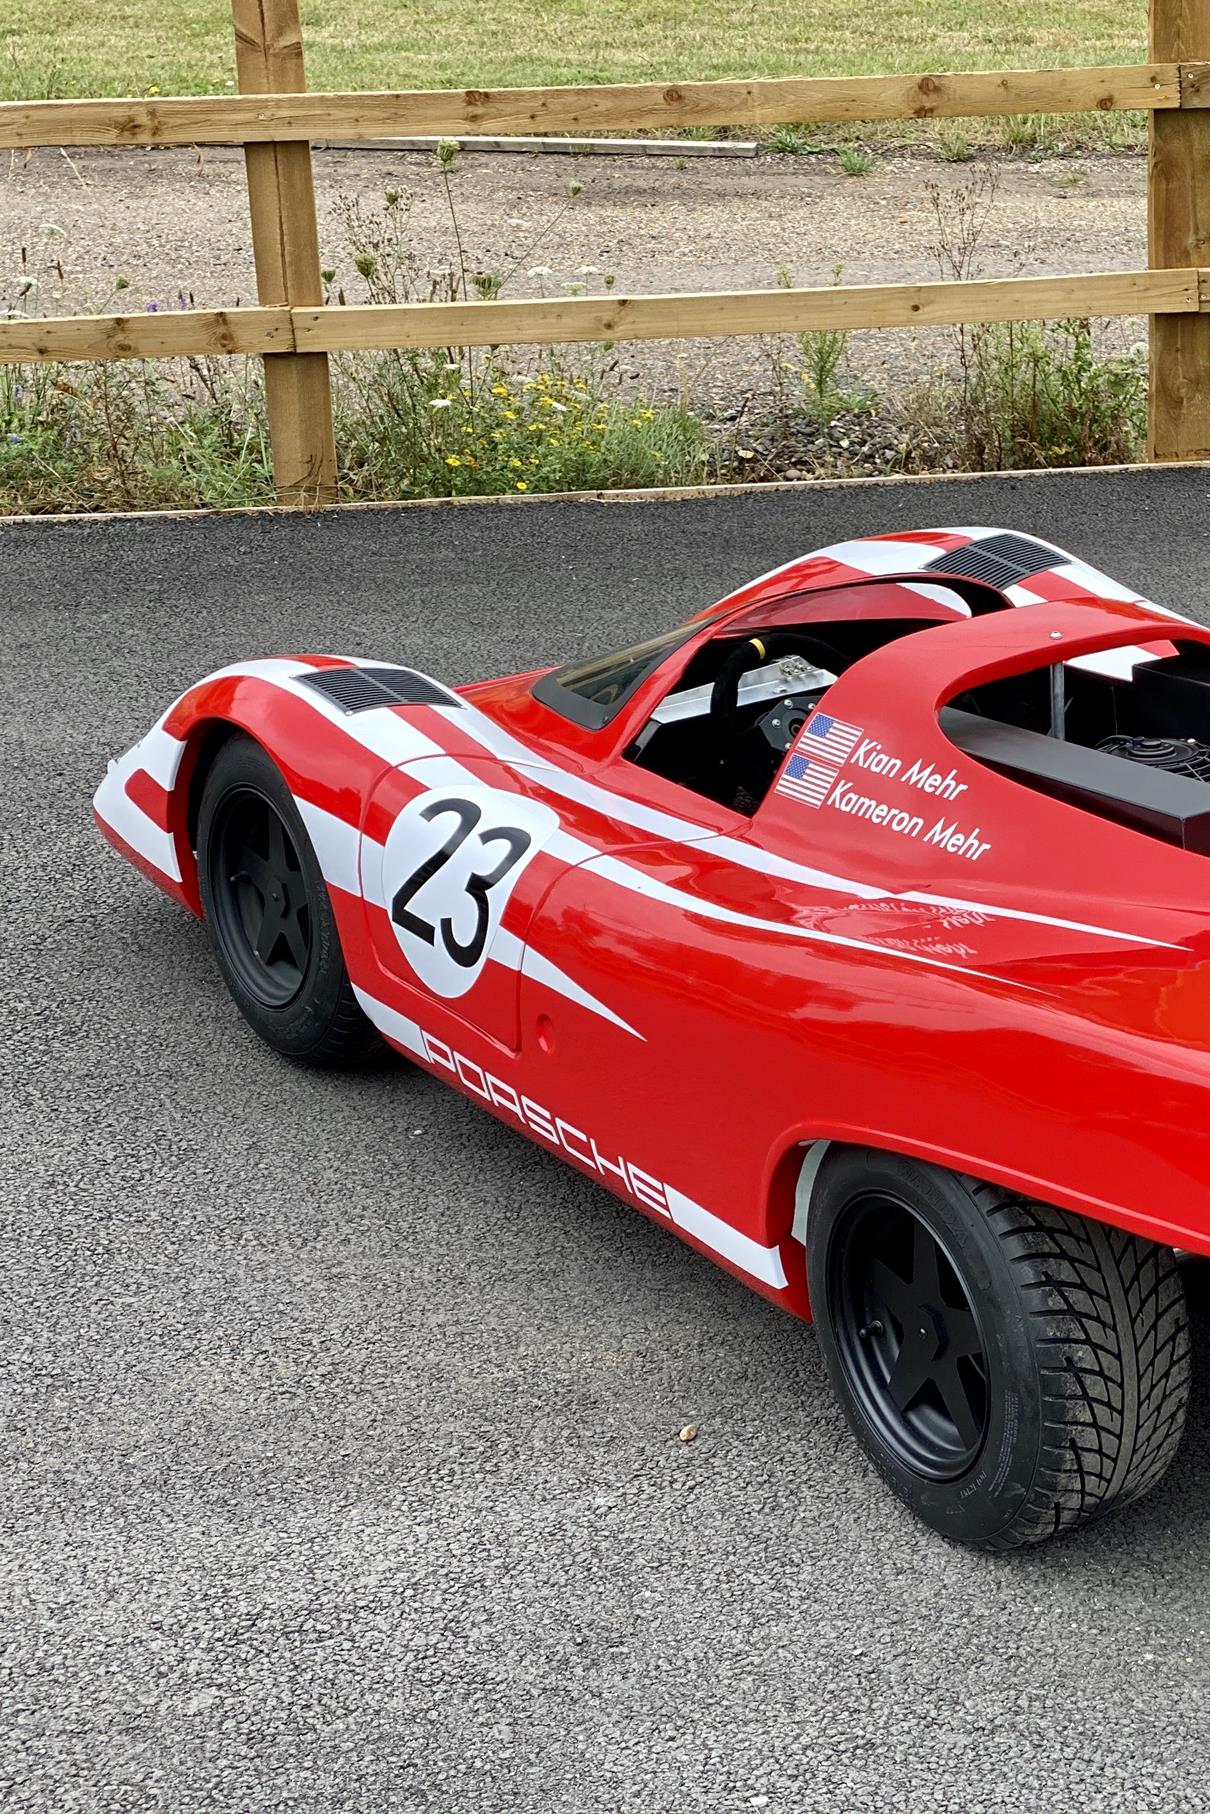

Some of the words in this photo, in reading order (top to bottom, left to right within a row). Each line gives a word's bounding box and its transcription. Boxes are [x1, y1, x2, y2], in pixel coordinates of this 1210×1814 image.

[826, 779, 924, 838] Kameron
[922, 817, 992, 861] Mehr
[850, 738, 902, 778] Kian
[900, 758, 969, 801] Mehr
[392, 798, 532, 968] 23
[421, 1029, 672, 1220] PORSCHE
